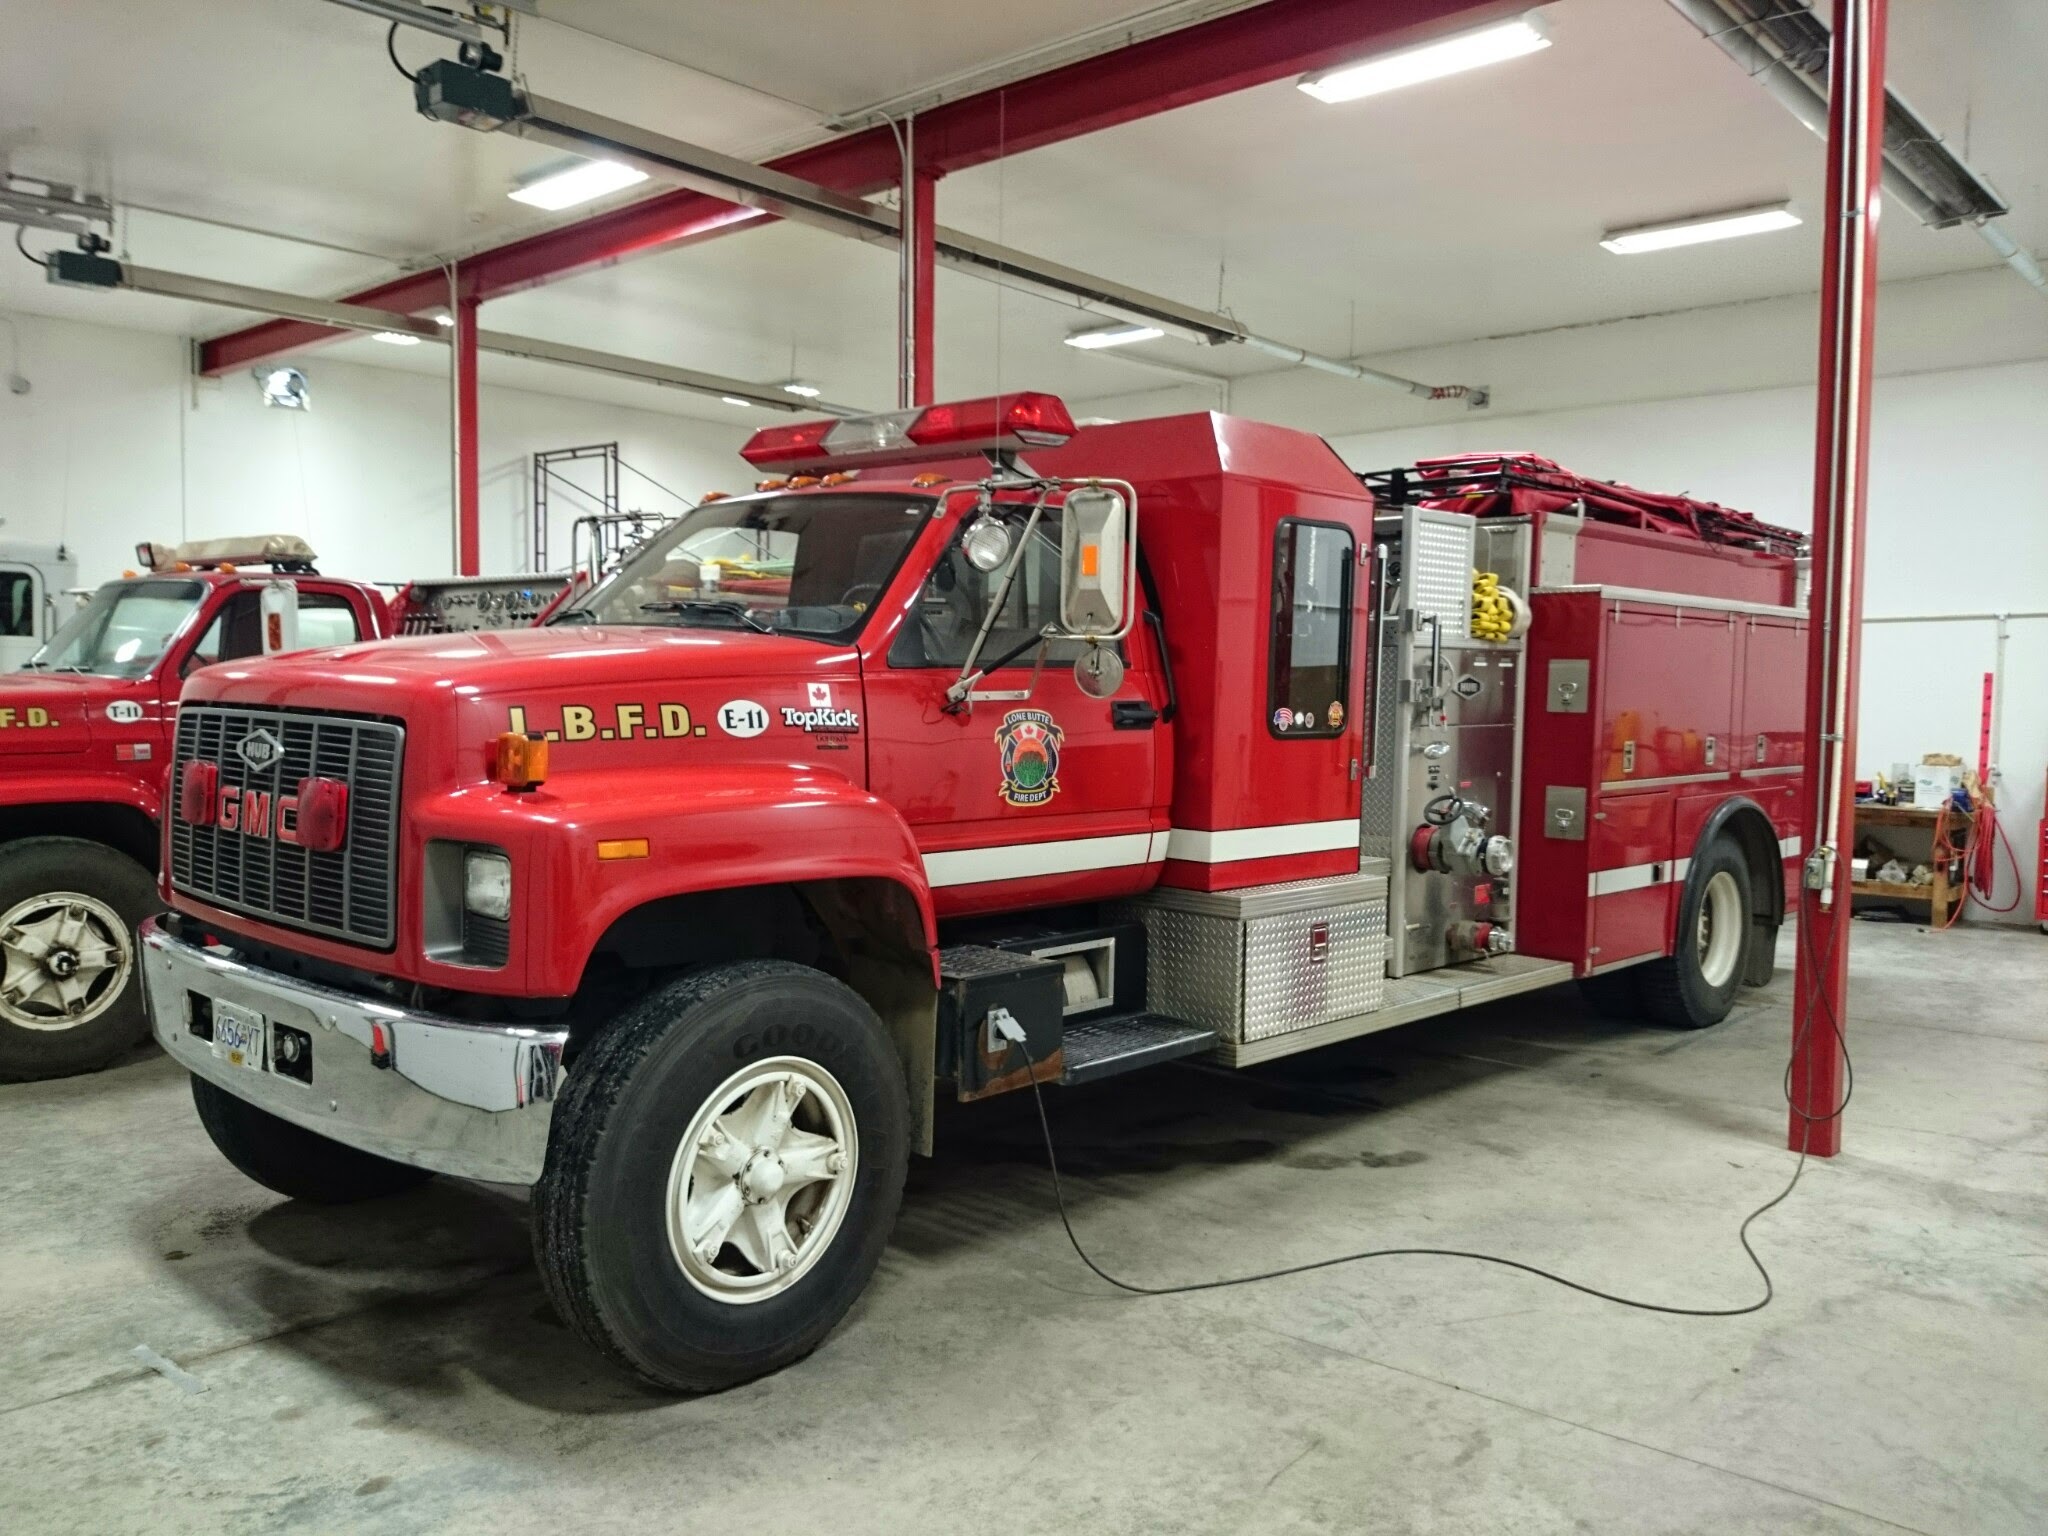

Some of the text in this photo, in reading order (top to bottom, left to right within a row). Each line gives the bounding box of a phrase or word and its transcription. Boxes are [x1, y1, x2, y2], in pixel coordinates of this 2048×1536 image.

[109, 706, 139, 718] T-11
[724, 709, 764, 729] E-11
[781, 707, 860, 732] TopKick
[1007, 712, 1050, 725] LONE BUTTE
[246, 741, 271, 760] HUB
[1014, 791, 1047, 802] FIRE DEPT
[217, 785, 299, 846] GMC
